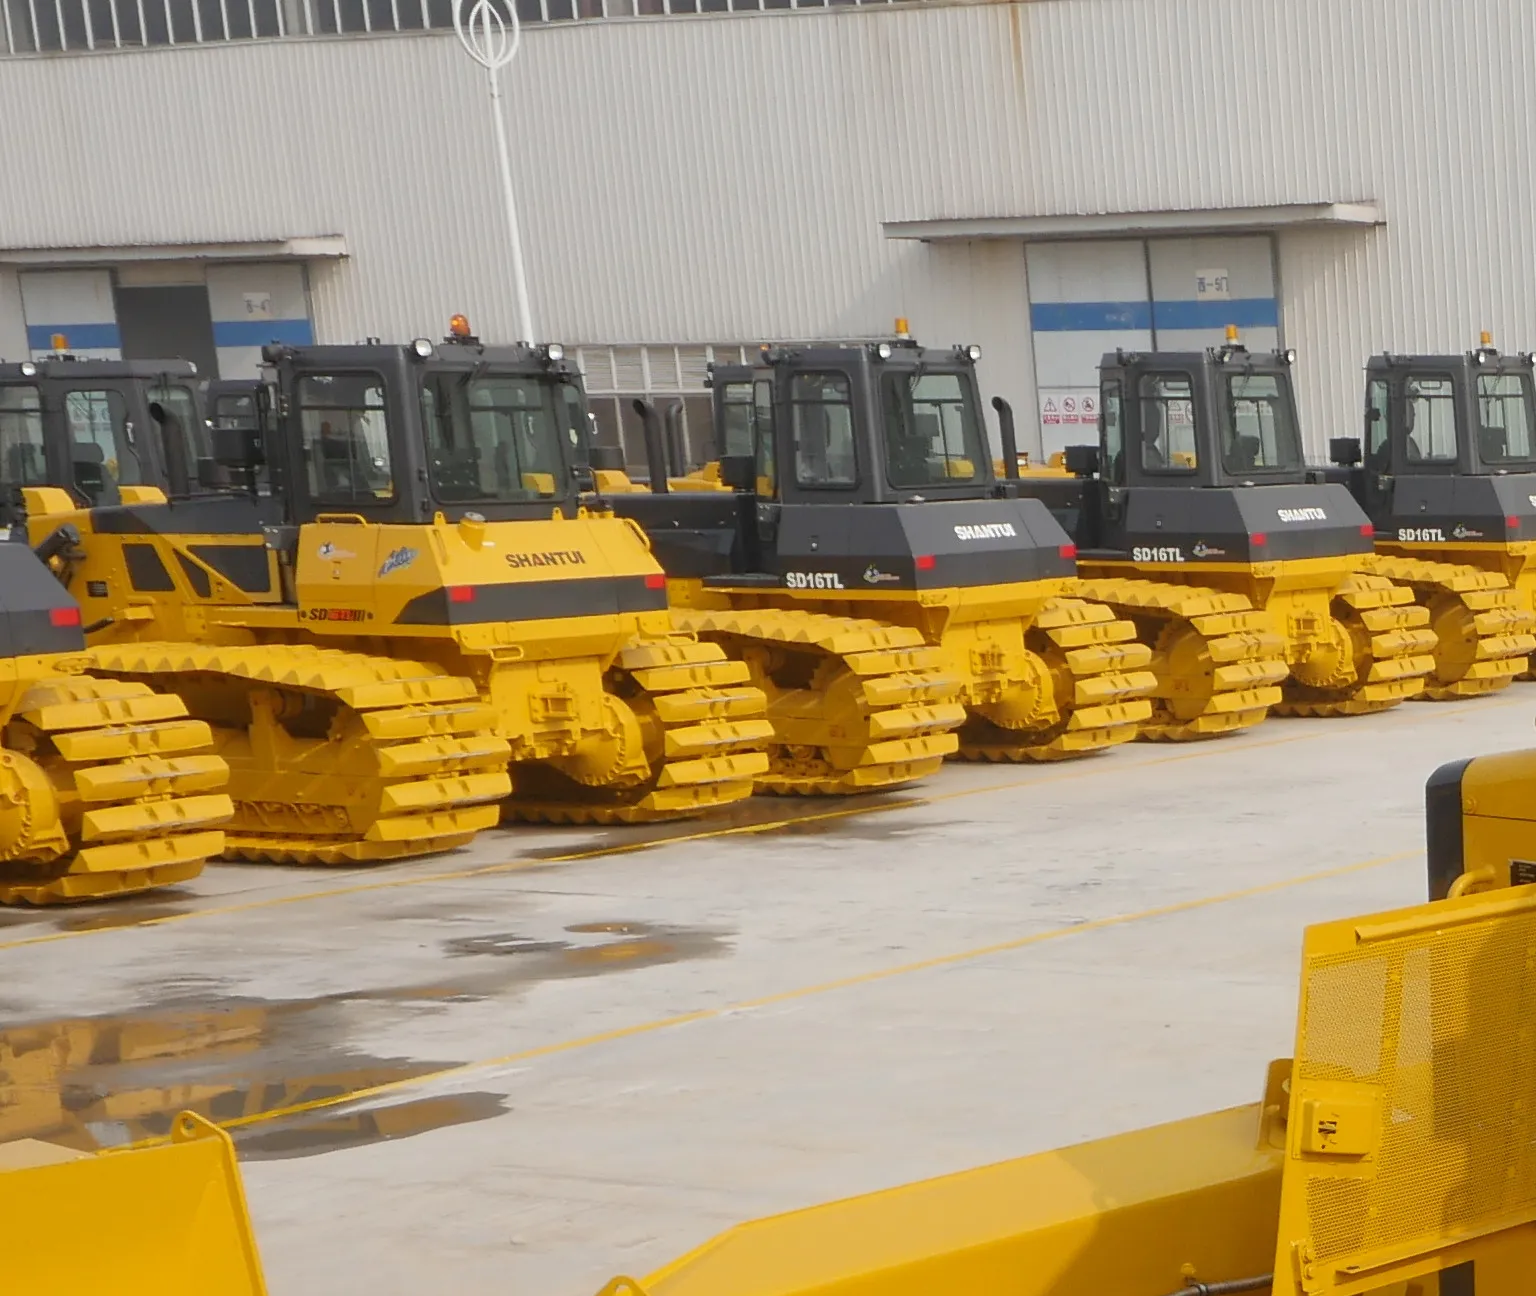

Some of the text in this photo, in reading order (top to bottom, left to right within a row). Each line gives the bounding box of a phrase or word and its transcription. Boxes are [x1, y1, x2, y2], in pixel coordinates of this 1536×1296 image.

[1277, 507, 1326, 522] SHANTUI
[954, 523, 1017, 540] SHANTUI
[1398, 528, 1446, 541] SD16TL
[505, 550, 586, 568] SHANTUI
[1132, 547, 1185, 562] SD16TL
[786, 572, 844, 589] SD16TL
